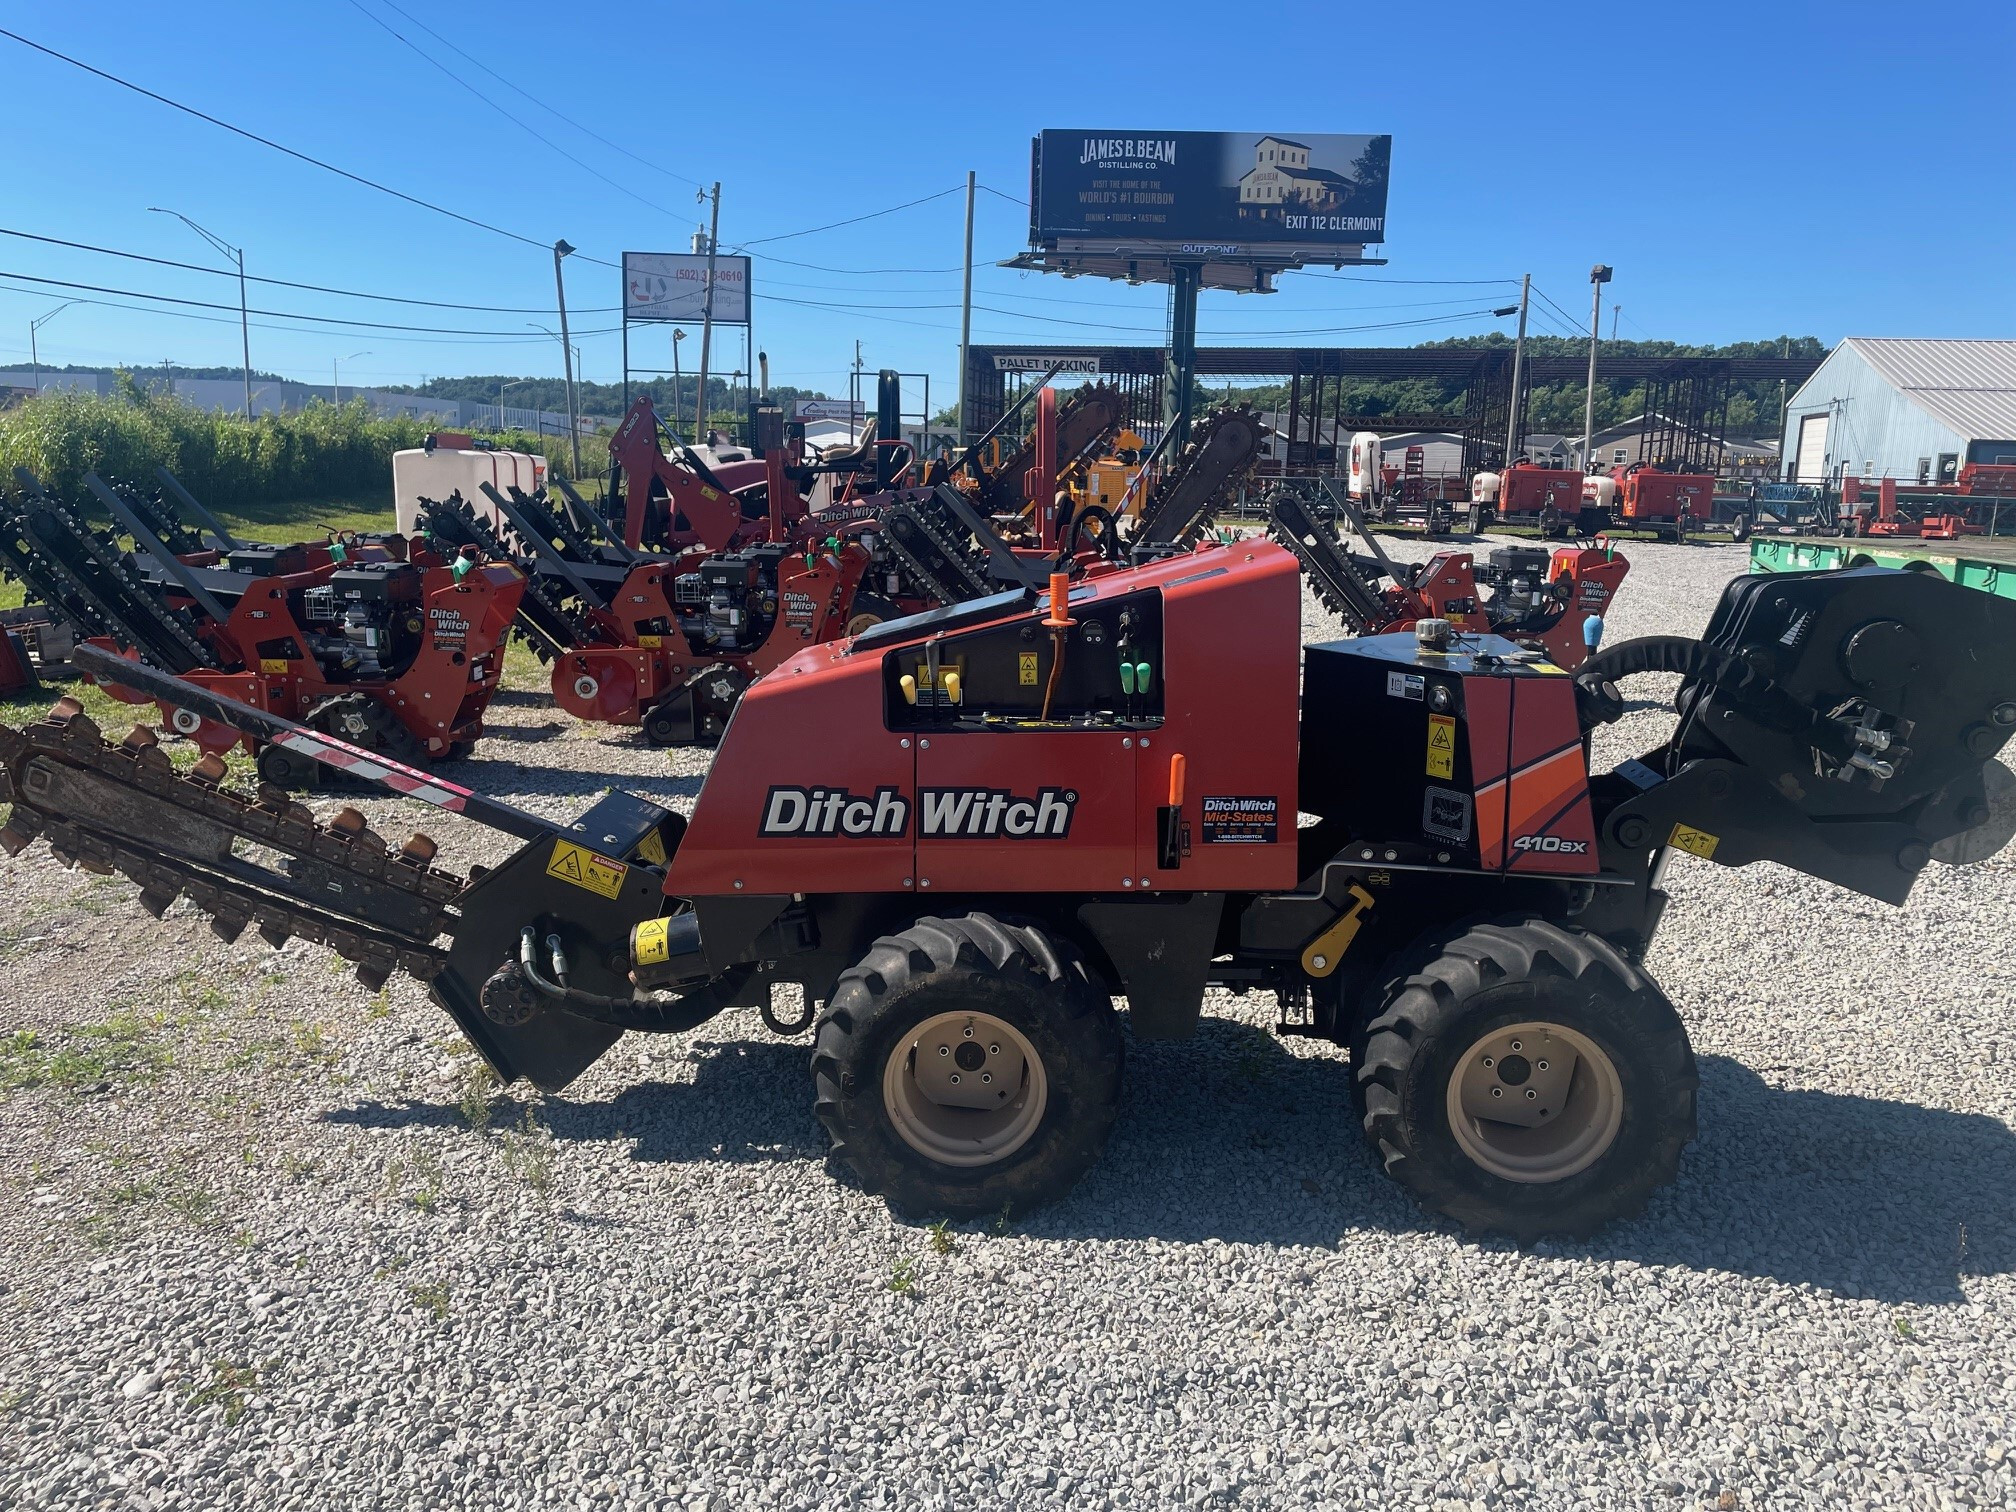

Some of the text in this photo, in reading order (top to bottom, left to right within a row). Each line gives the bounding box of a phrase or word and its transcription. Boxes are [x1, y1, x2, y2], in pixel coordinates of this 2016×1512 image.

[1080, 139, 1176, 165] JAMES B. BEAM
[1098, 161, 1144, 169] DISTILLING
[1092, 180, 1161, 190] VISIT THE HOME OF THE
[1079, 191, 1175, 205] WORLD'S #1 BOURBON
[1085, 213, 1167, 223] DINING TOURS TASTINGS
[1285, 215, 1384, 231] EXIT 112 CLERMONT
[675, 269, 698, 283] (502)
[1000, 358, 1040, 369] PALLET
[820, 510, 849, 523] Ditch
[1580, 580, 1604, 589] Ditch
[783, 593, 809, 602] Ditch
[1585, 588, 1610, 597] Witch
[790, 602, 817, 610] Witch
[429, 609, 460, 619] Ditch
[437, 619, 470, 630] Witch
[1204, 800, 1276, 811] Ditch Witch
[764, 790, 904, 833] Ditch
[1204, 811, 1274, 822] Mid-States
